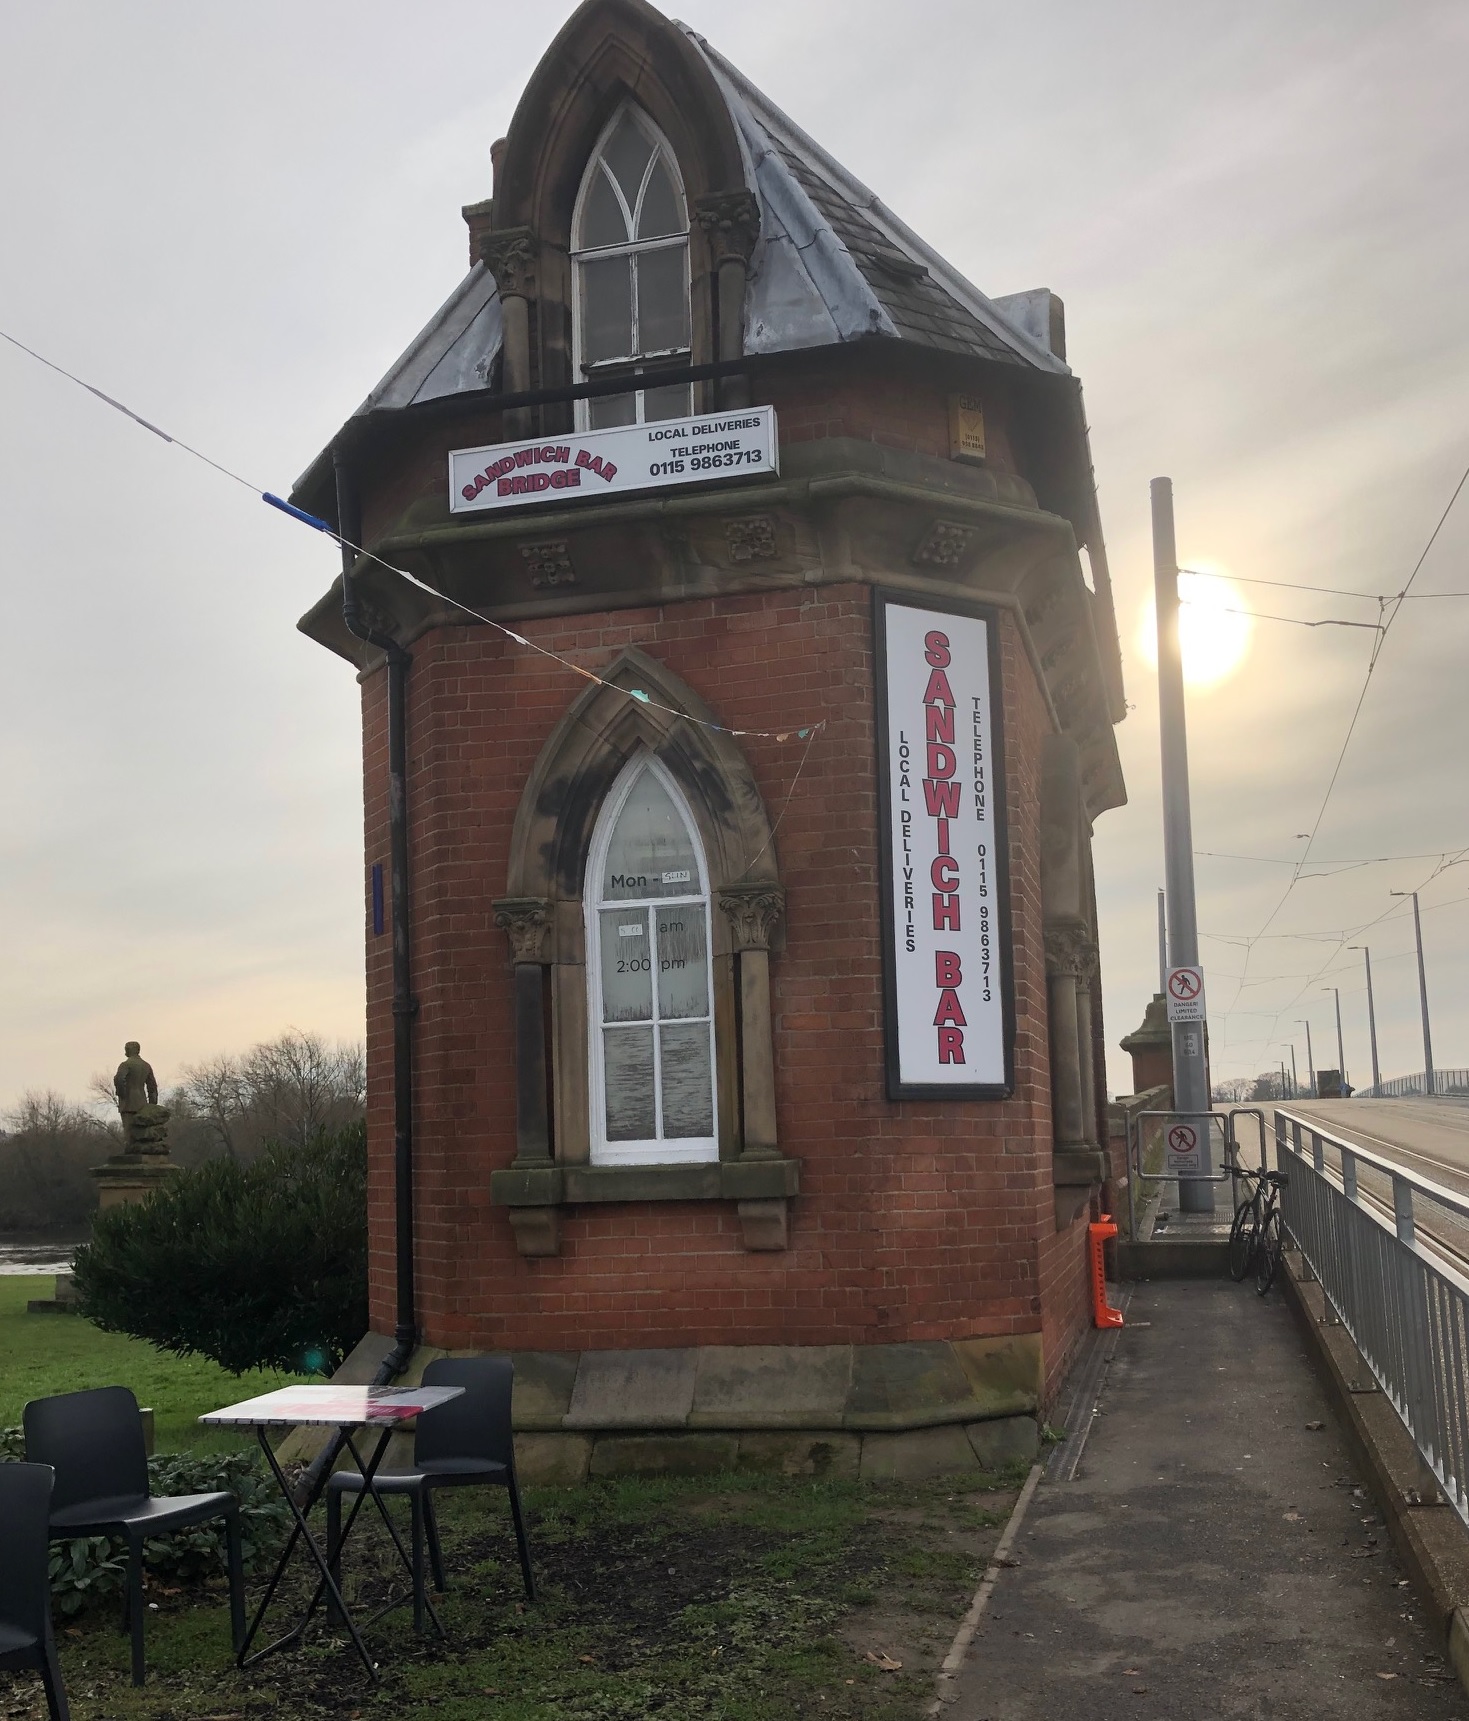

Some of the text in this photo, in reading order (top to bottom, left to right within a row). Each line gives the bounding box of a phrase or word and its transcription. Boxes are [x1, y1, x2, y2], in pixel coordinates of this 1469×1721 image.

[648, 417, 761, 441] LOCAL DELIVERIES
[649, 449, 762, 476] 0115 9863713
[670, 440, 740, 458] TELEPHONE
[462, 445, 618, 501] SANDWICH BAR
[497, 468, 581, 497] BRIDGE
[899, 730, 915, 952] LOCAL DELIVERIES
[922, 630, 967, 1064] SANDWICH BAR
[972, 697, 991, 1002] TELEPHONE 0115 9863713
[611, 874, 647, 888] Mon
[660, 921, 684, 933] am
[617, 958, 685, 973] 2:00 pm
